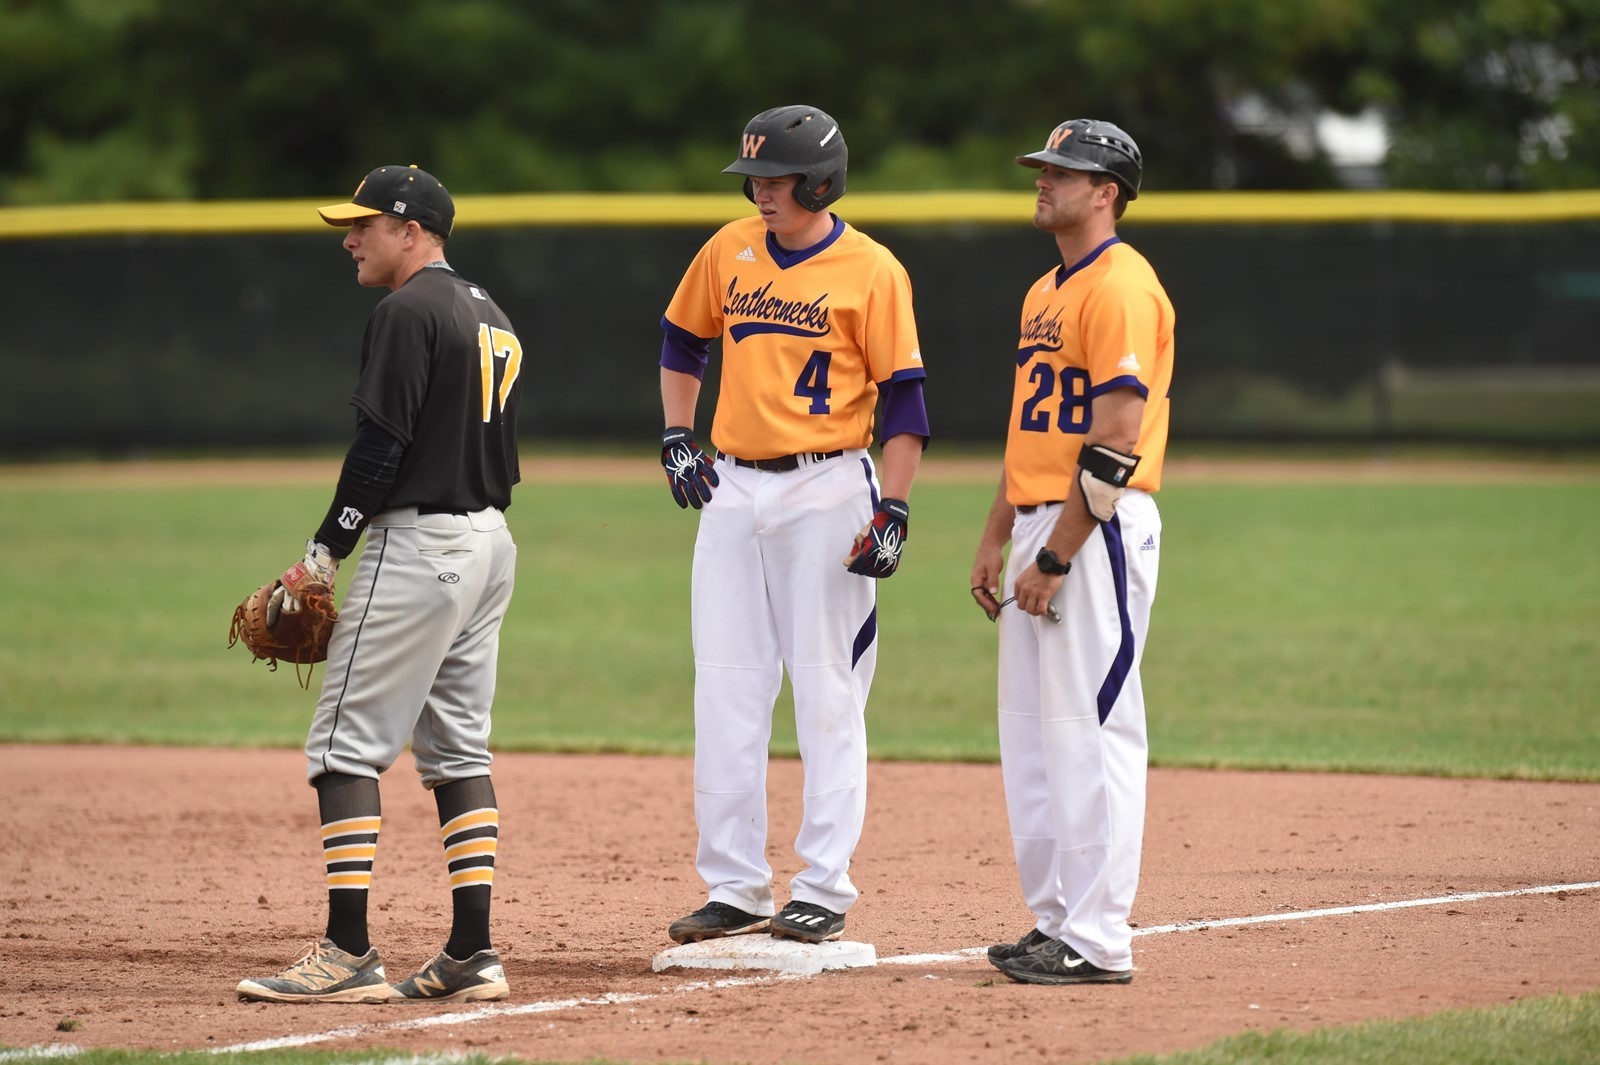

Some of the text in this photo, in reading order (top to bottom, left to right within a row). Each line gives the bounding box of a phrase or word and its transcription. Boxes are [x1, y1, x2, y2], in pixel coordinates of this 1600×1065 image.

[742, 133, 766, 159] W
[1046, 128, 1073, 150] W
[723, 275, 829, 330] Leathernecks
[478, 323, 523, 422] 17
[793, 350, 832, 415] 4
[1020, 362, 1093, 434] 28
